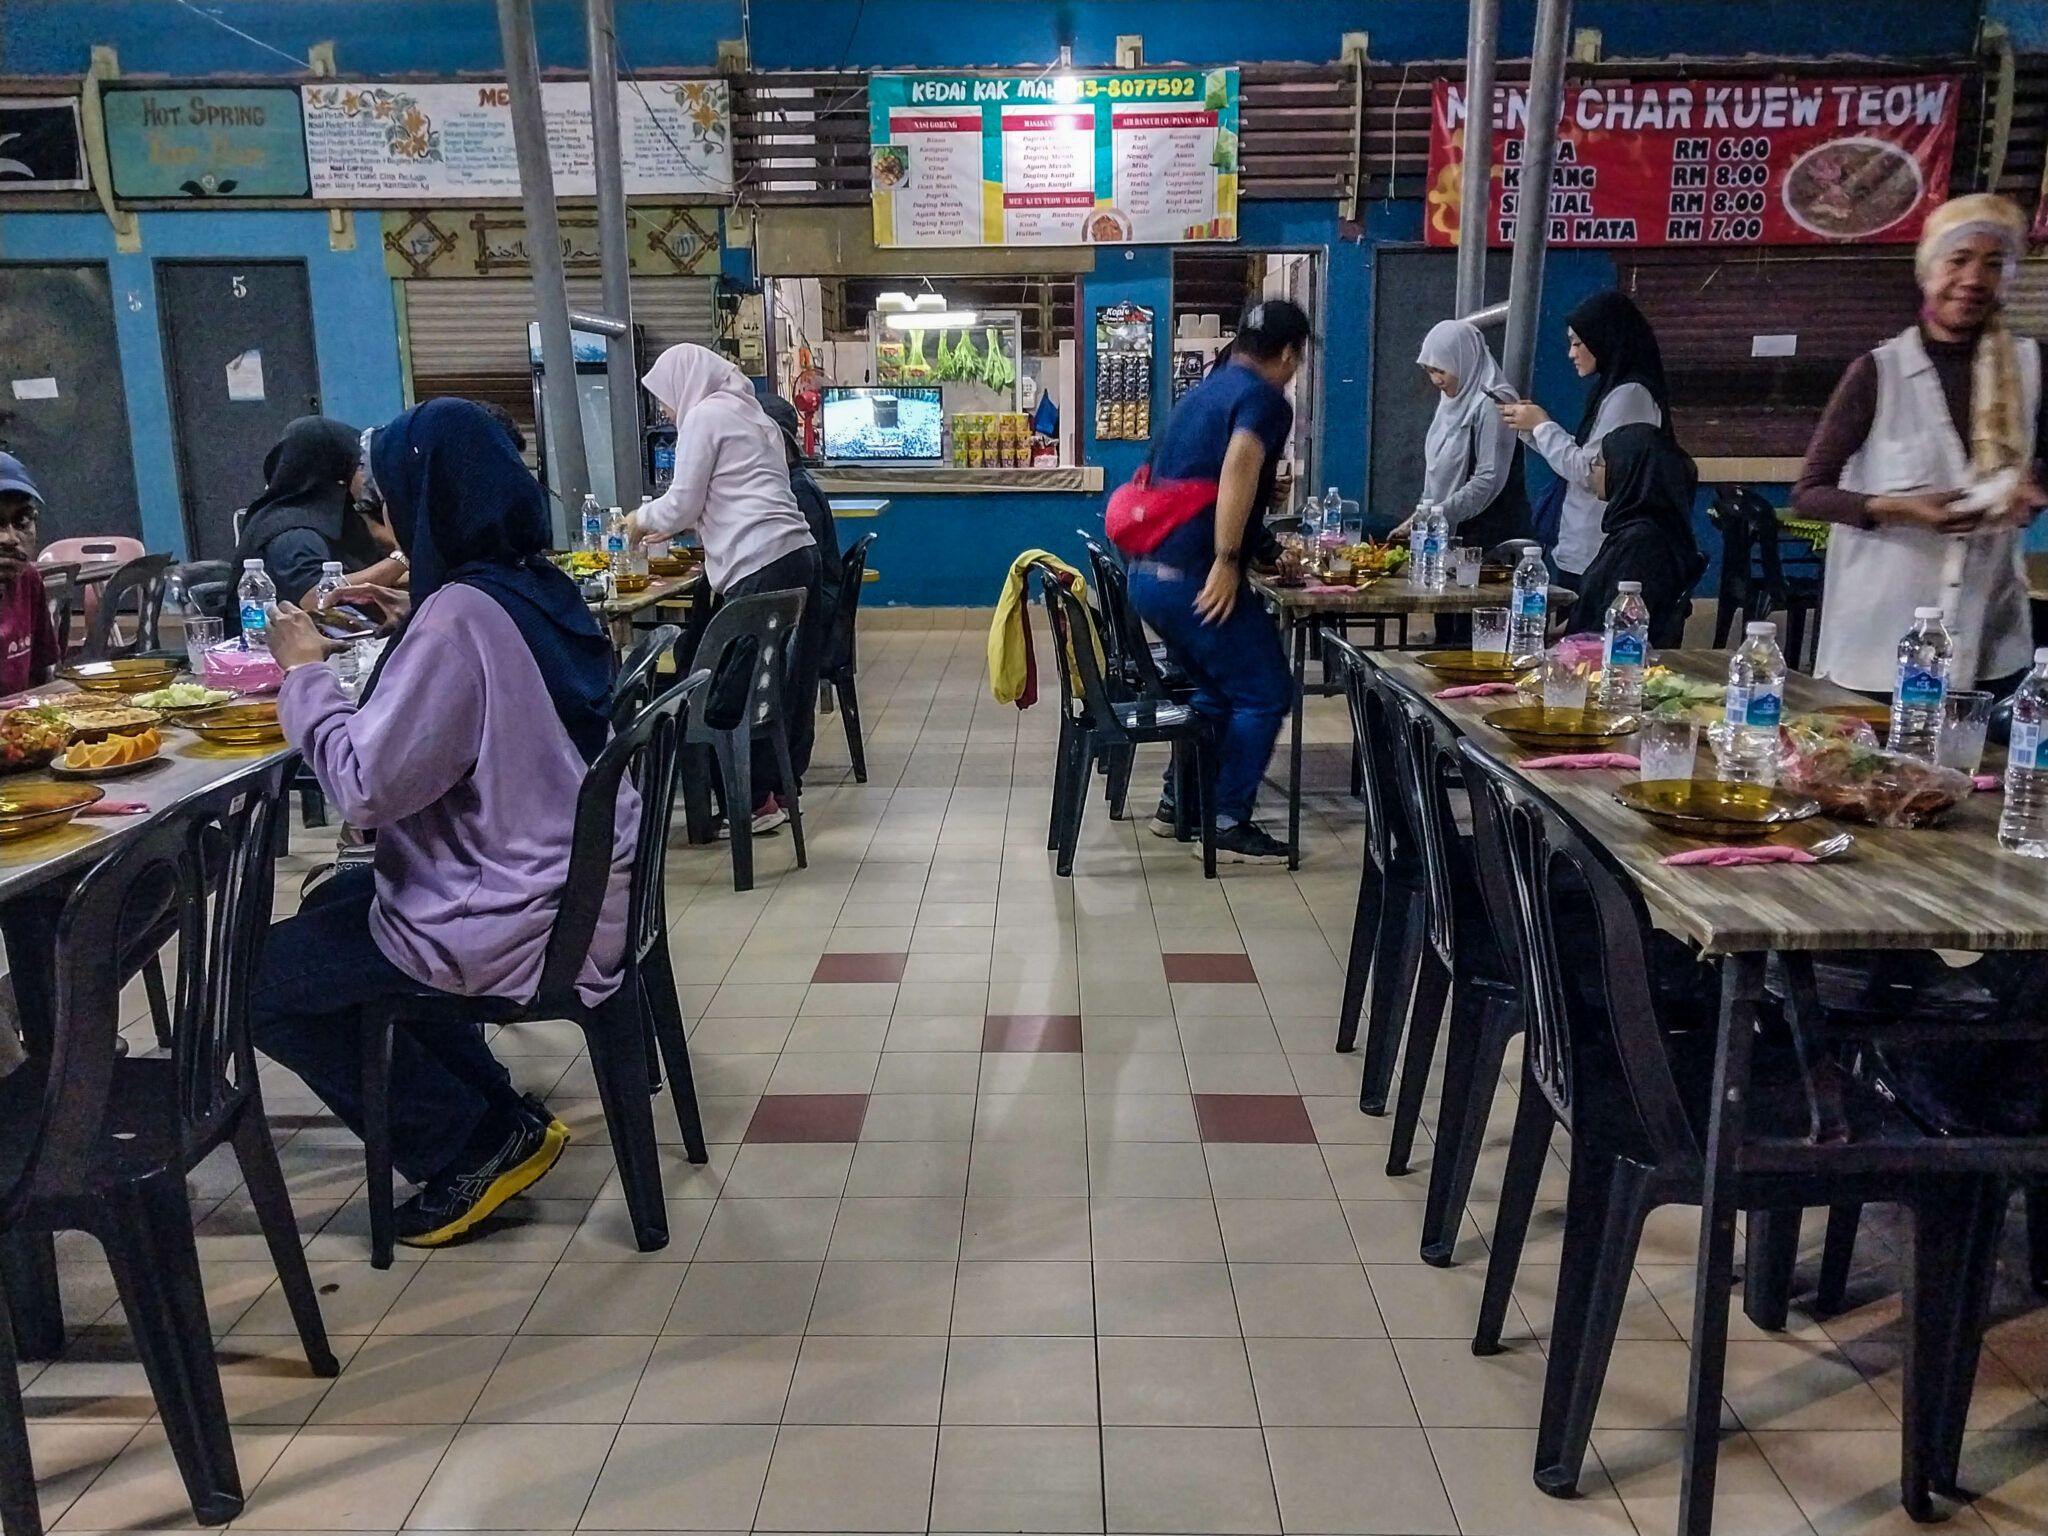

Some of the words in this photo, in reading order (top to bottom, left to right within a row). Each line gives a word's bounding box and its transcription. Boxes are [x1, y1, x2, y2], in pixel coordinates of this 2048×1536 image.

[478, 88, 510, 108] ME
[973, 80, 1011, 102] KAK
[1076, 77, 1195, 98] 13-8077592
[189, 96, 265, 127] SPRING
[1447, 86, 1565, 130] MEN
[1576, 88, 1694, 129] CHAR
[1703, 86, 1822, 129] KUEW
[1831, 80, 1951, 127] TEOW
[1673, 138, 1711, 161] RM
[1716, 137, 1771, 161] 6.00
[1502, 166, 1597, 188] KANG
[1671, 165, 1709, 188] RM
[1714, 164, 1769, 187] 8.00
[1501, 193, 1594, 216] SIAL
[1669, 191, 1706, 214] RM
[1711, 190, 1766, 214] 8.00
[1573, 218, 1637, 241] MATA
[1666, 217, 1703, 241] RM
[1708, 217, 1763, 240] 7.00
[231, 275, 248, 298] 5
